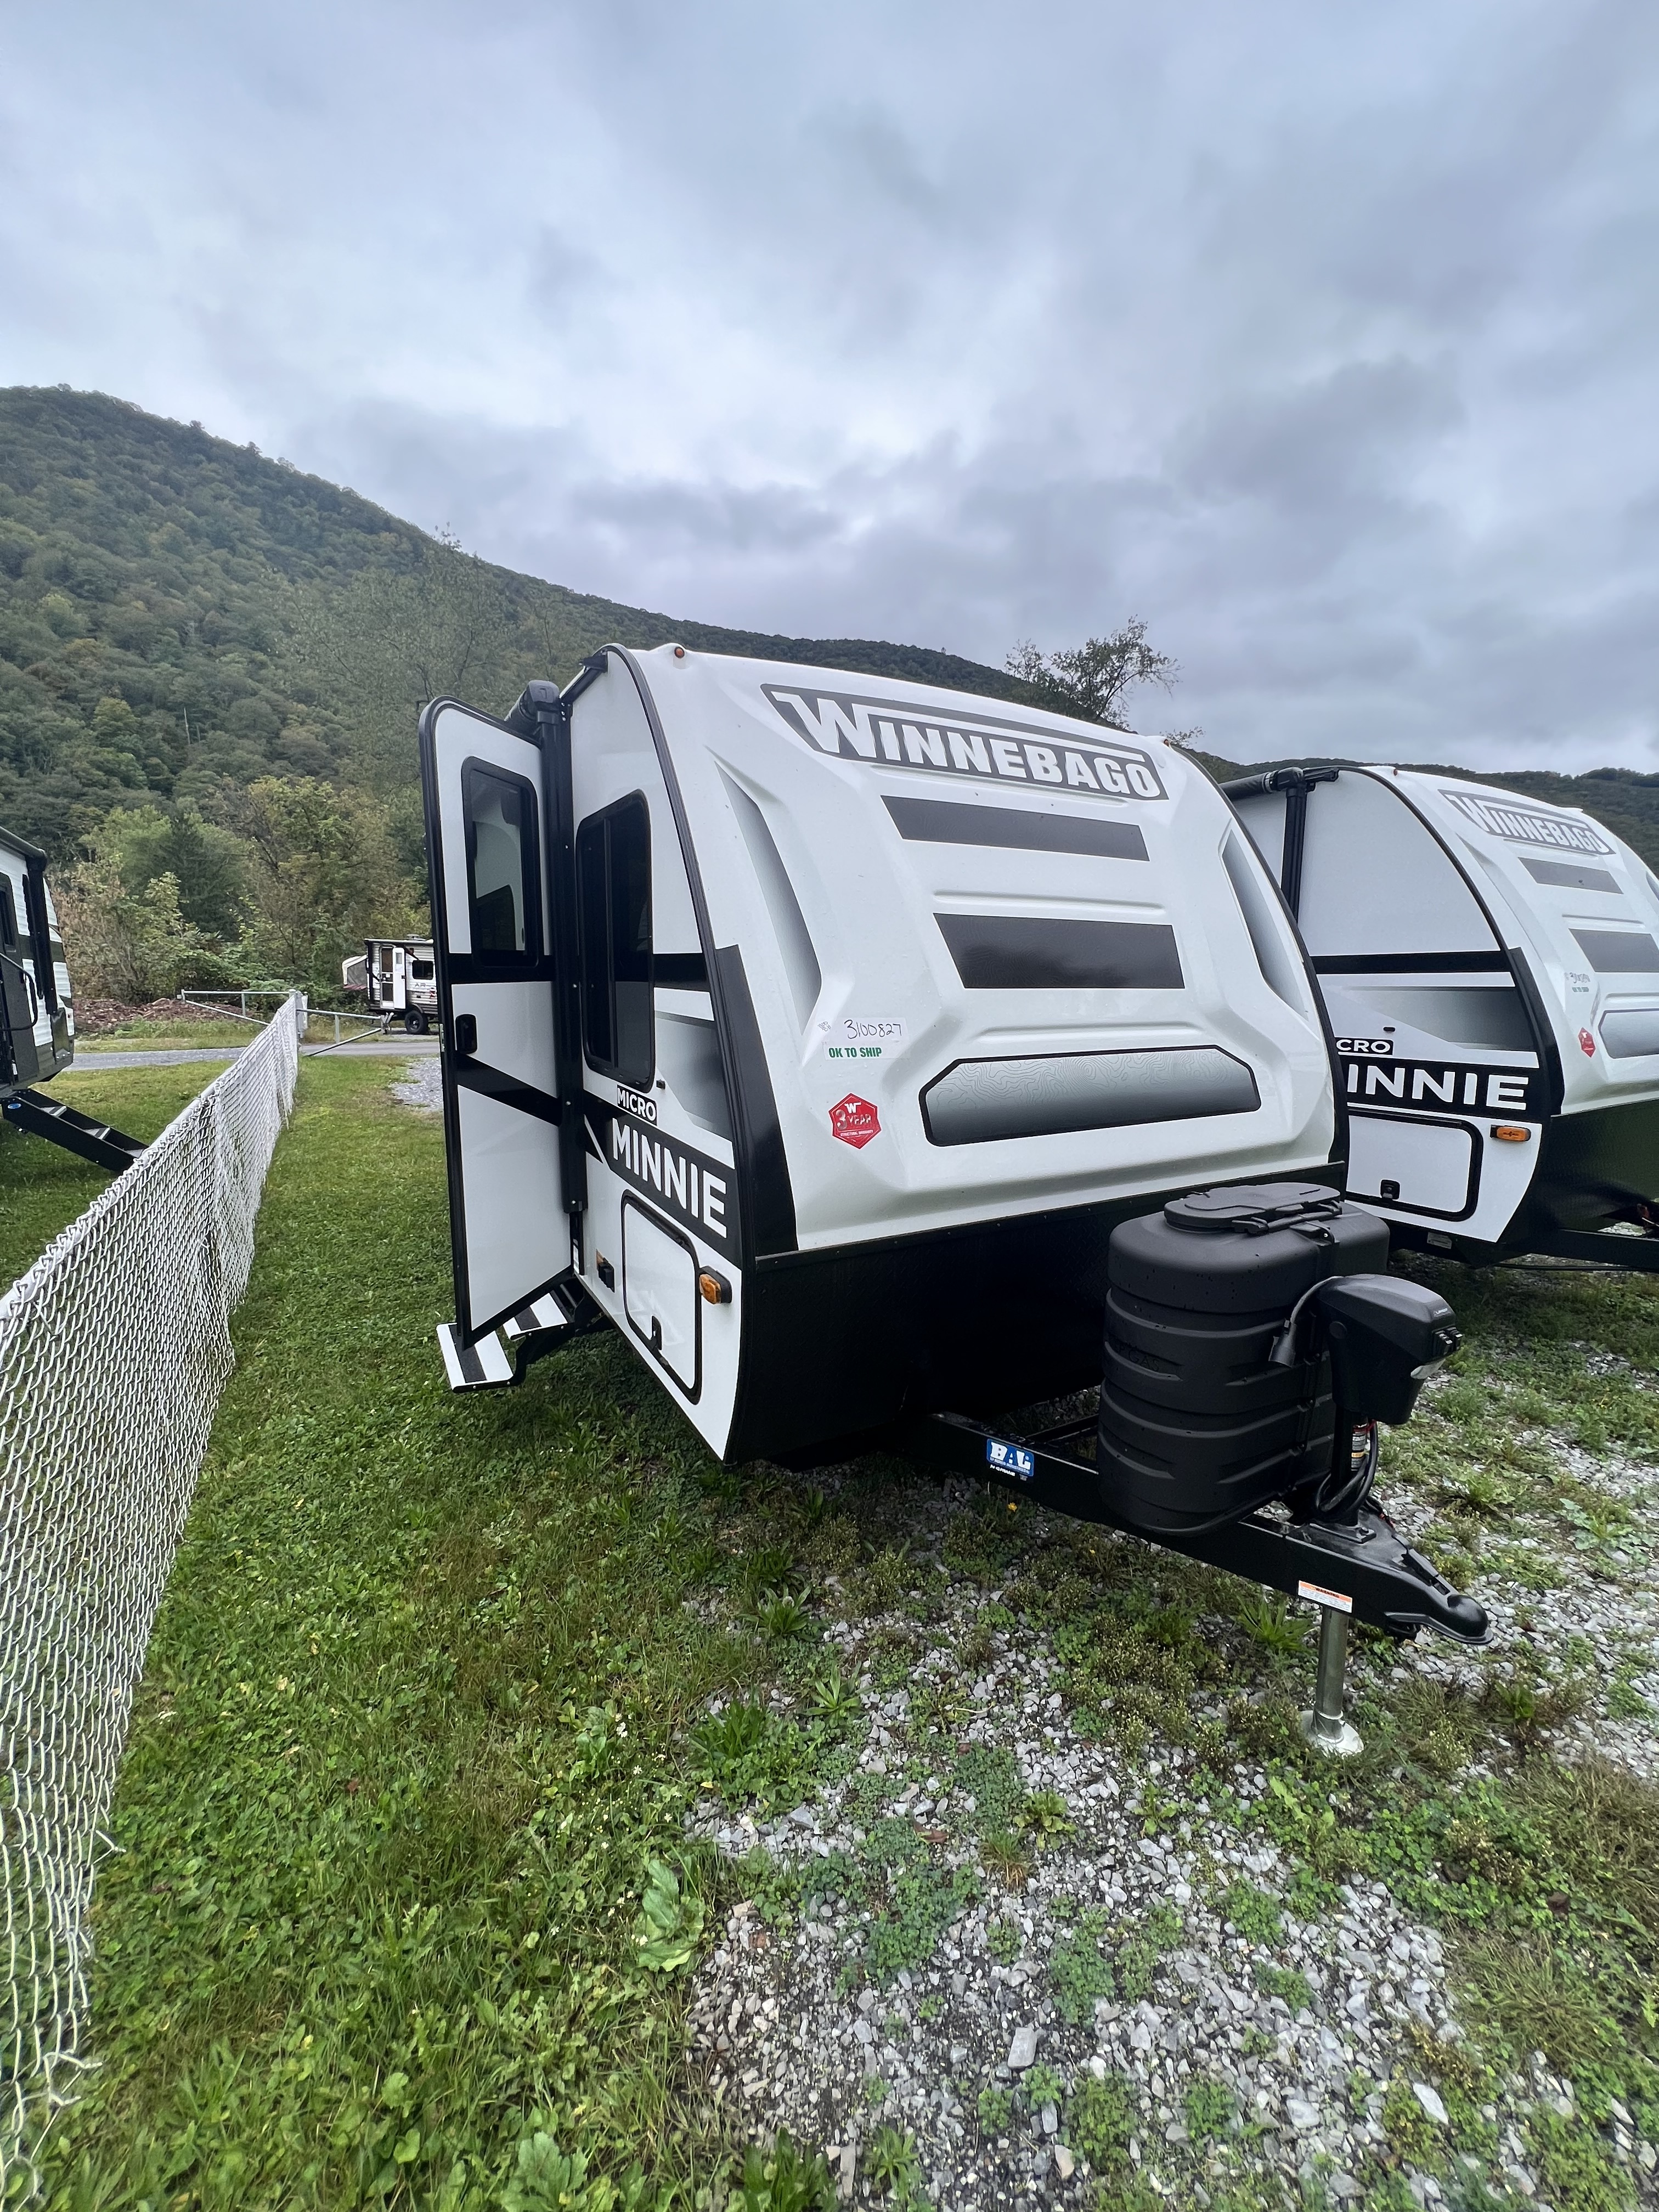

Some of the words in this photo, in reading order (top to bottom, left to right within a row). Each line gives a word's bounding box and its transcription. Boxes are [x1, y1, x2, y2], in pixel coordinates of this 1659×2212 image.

[771, 690, 1161, 798] WINNEBAGO
[1444, 794, 1611, 853] WINNEBAGO
[844, 1019, 903, 1040] 3100827
[828, 1048, 843, 1058] OK
[845, 1047, 857, 1058] TO
[860, 1047, 882, 1058] SHIP
[1336, 1039, 1391, 1053] CRO
[1347, 1064, 1529, 1110] INNIE
[617, 1088, 656, 1121] MICRO
[836, 1109, 847, 1130] 3
[848, 1114, 871, 1126] YEAR
[612, 1118, 727, 1238] MINNIE
[990, 1442, 1031, 1470] BAL
[1316, 1588, 1340, 1598] WARNING
